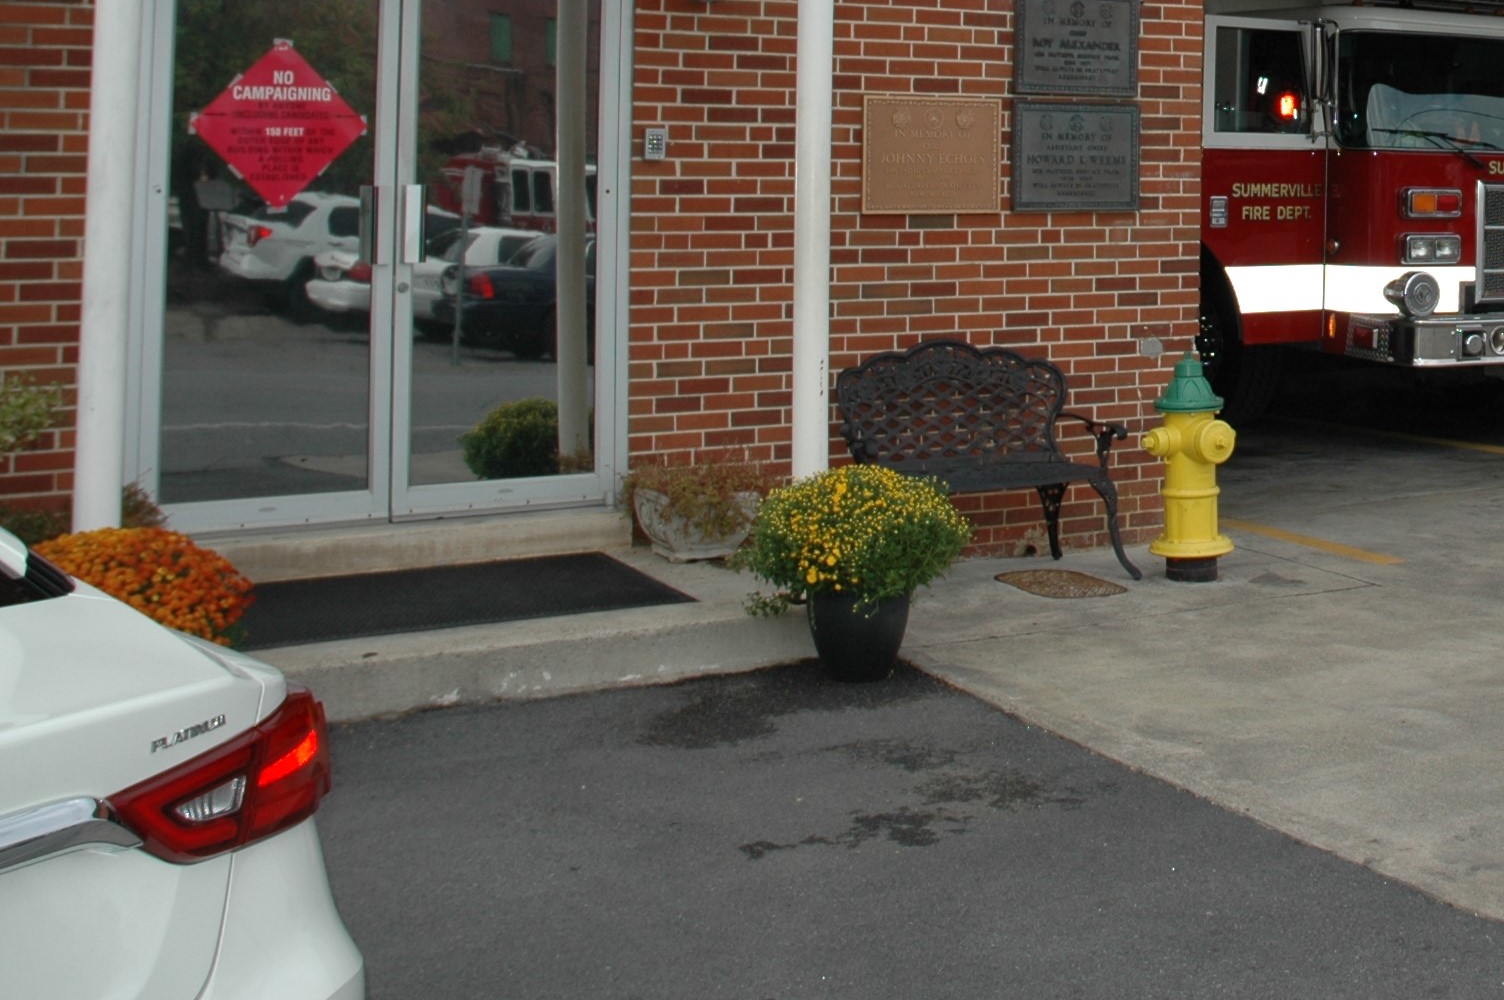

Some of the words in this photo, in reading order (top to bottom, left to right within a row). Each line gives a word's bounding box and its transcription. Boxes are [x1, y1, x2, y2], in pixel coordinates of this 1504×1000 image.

[1044, 17, 1055, 25] IN
[1059, 39, 1120, 52] ALEXANDER
[273, 71, 294, 85] NO
[233, 85, 331, 102] CAMPAIGNING
[265, 127, 281, 136] 150
[283, 127, 305, 137] FEET
[894, 130, 906, 138] IN
[1041, 133, 1053, 141] IN
[1057, 133, 1096, 142] MEMORY
[1101, 134, 1112, 142] OF
[880, 153, 934, 164] JOHNNY
[939, 154, 984, 164] ECHOLS
[1026, 154, 1074, 165] HOWARD
[1232, 182, 1322, 198] SUMMERVILLE
[1241, 206, 1271, 220] FIRE
[1276, 206, 1312, 220] DEPT.
